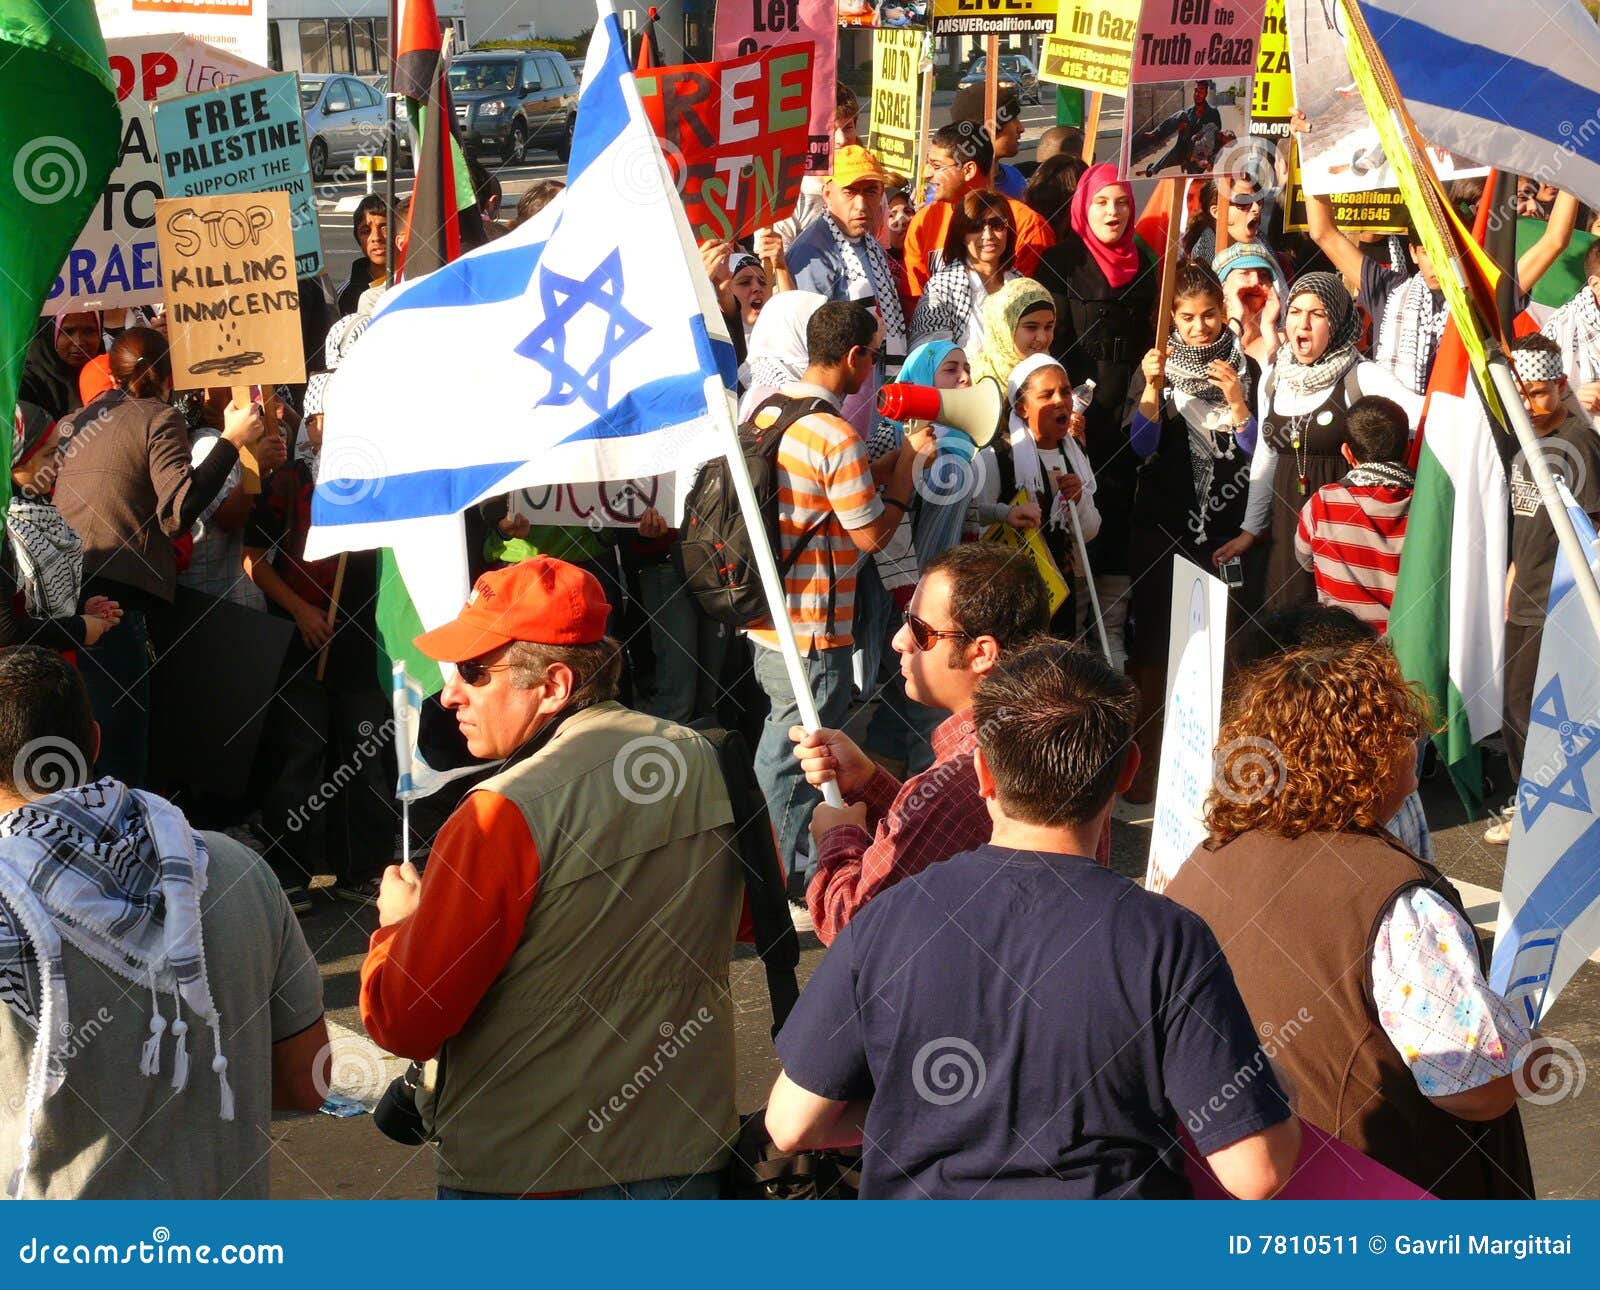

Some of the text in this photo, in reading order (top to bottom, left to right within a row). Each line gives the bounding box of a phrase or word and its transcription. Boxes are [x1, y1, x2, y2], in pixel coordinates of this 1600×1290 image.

[936, 17, 1054, 33] ANSWERcoalition.org
[1072, 6, 1136, 43] in Gaz
[1214, 8, 1234, 25] the
[882, 48, 910, 83] AID TO
[1141, 32, 1253, 66] Truth of Gaza
[108, 52, 179, 102] OP
[185, 87, 271, 140] FREE
[875, 89, 911, 131] ISRAEL
[165, 120, 301, 178] PALESTINE
[184, 157, 291, 198] SUPPORT THE
[167, 205, 274, 257] STOP
[1334, 207, 1391, 221] .821.6545
[171, 254, 288, 292] KILLING
[174, 290, 300, 323] INNOCENTS
